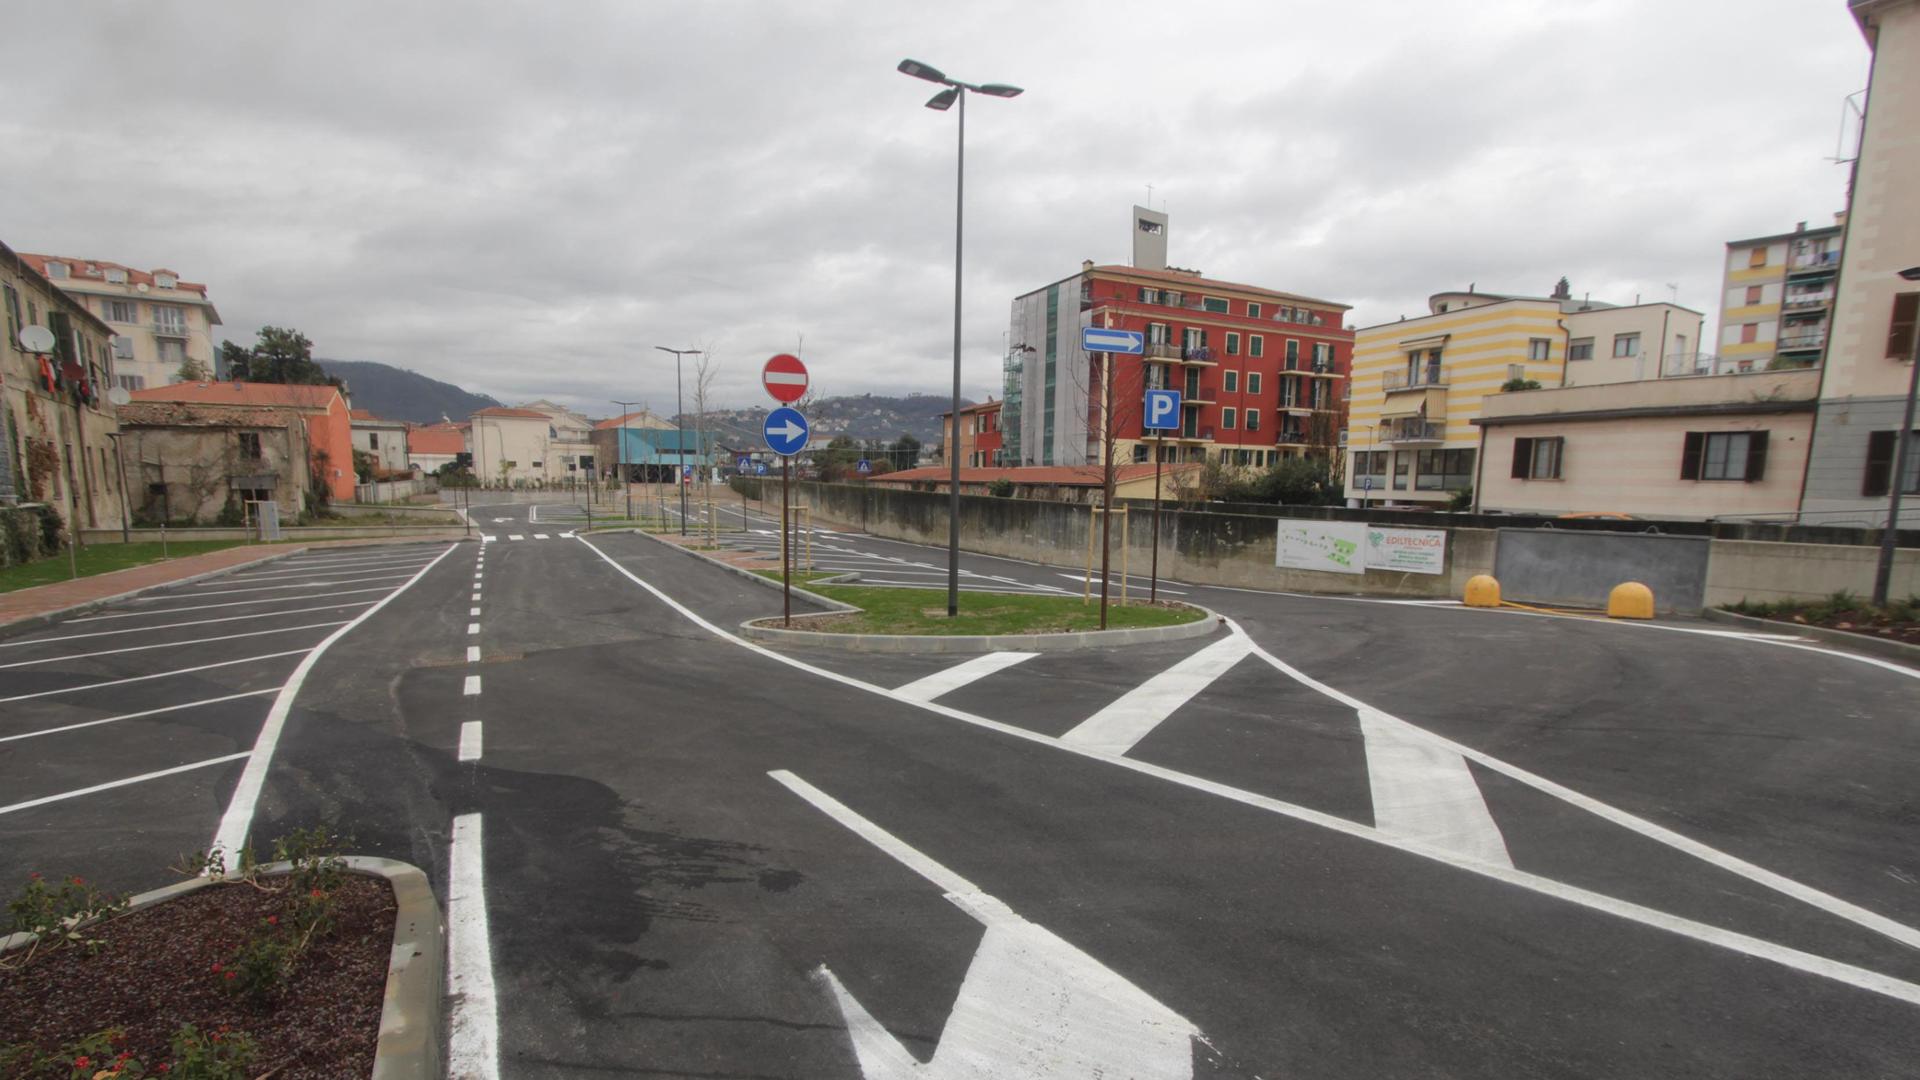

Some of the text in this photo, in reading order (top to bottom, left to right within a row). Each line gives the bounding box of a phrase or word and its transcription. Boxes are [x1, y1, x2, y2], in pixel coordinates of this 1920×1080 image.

[1152, 394, 1173, 424] P
[683, 465, 689, 474] P
[1365, 480, 1371, 489] P
[1386, 536, 1440, 546] EDILTECNICA
